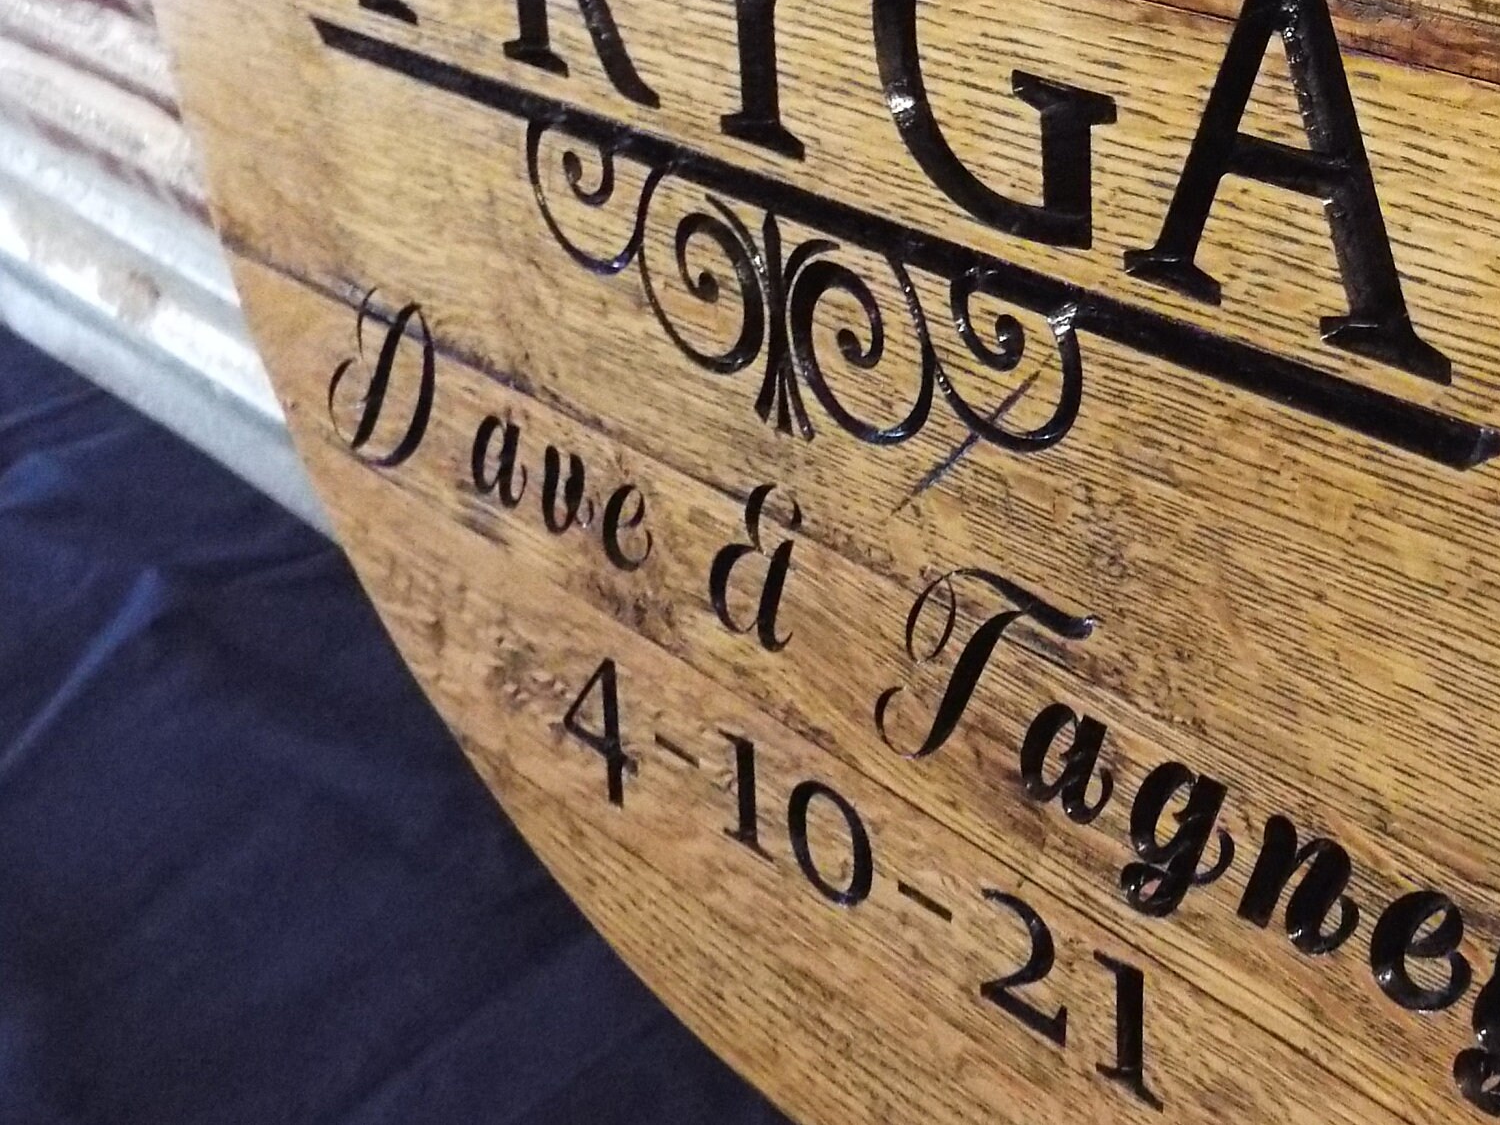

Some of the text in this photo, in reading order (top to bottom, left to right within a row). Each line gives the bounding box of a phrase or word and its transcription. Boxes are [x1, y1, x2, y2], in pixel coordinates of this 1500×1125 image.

[327, 286, 654, 572] Dave
[709, 484, 801, 652] &
[562, 657, 1165, 1113] 4-10-21
